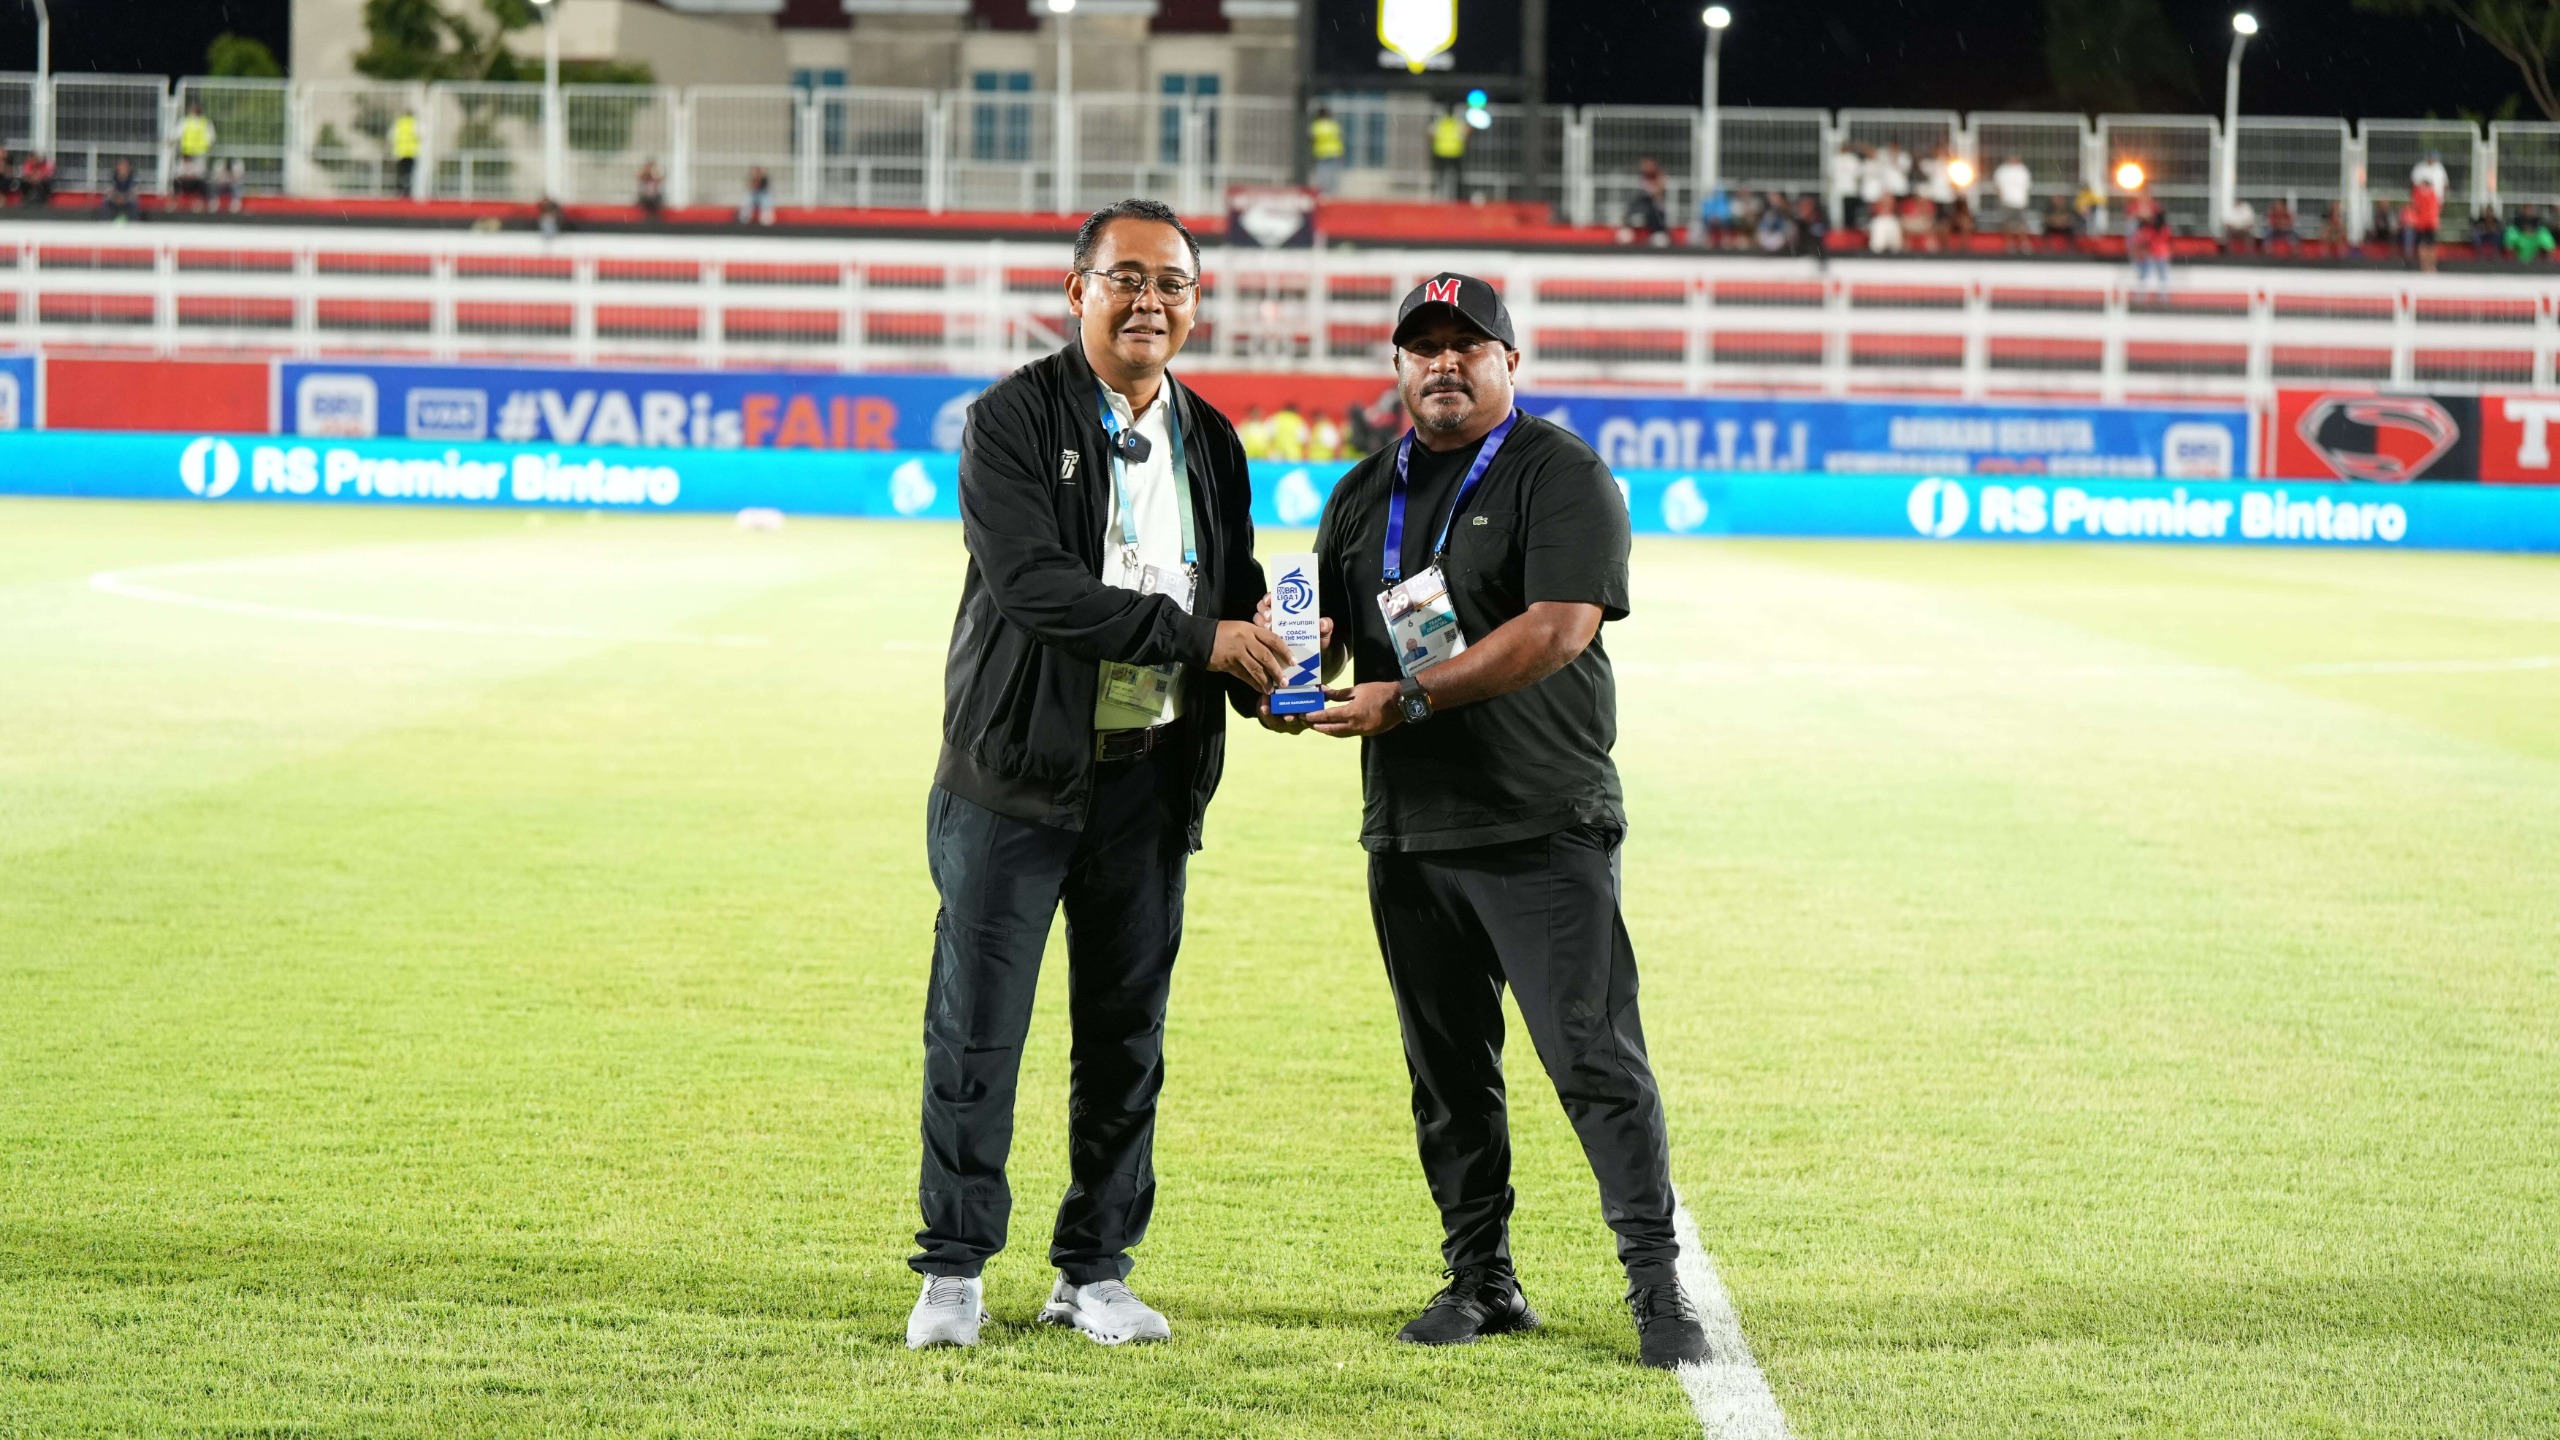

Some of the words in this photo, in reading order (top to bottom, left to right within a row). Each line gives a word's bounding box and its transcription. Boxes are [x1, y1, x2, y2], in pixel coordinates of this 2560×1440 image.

[1425, 278, 1461, 307] M
[495, 389, 898, 450] #VARisFAIR
[252, 446, 318, 493] RS
[324, 449, 506, 499] Premier
[511, 452, 680, 505] Bintaro
[1980, 485, 2047, 533] RS
[2053, 487, 2233, 537] Premier
[2240, 489, 2407, 541] Bintaro
[1387, 593, 1409, 617] 29
[1427, 619, 1448, 633] OFFICIAL
[1429, 616, 1443, 627] TEAM
